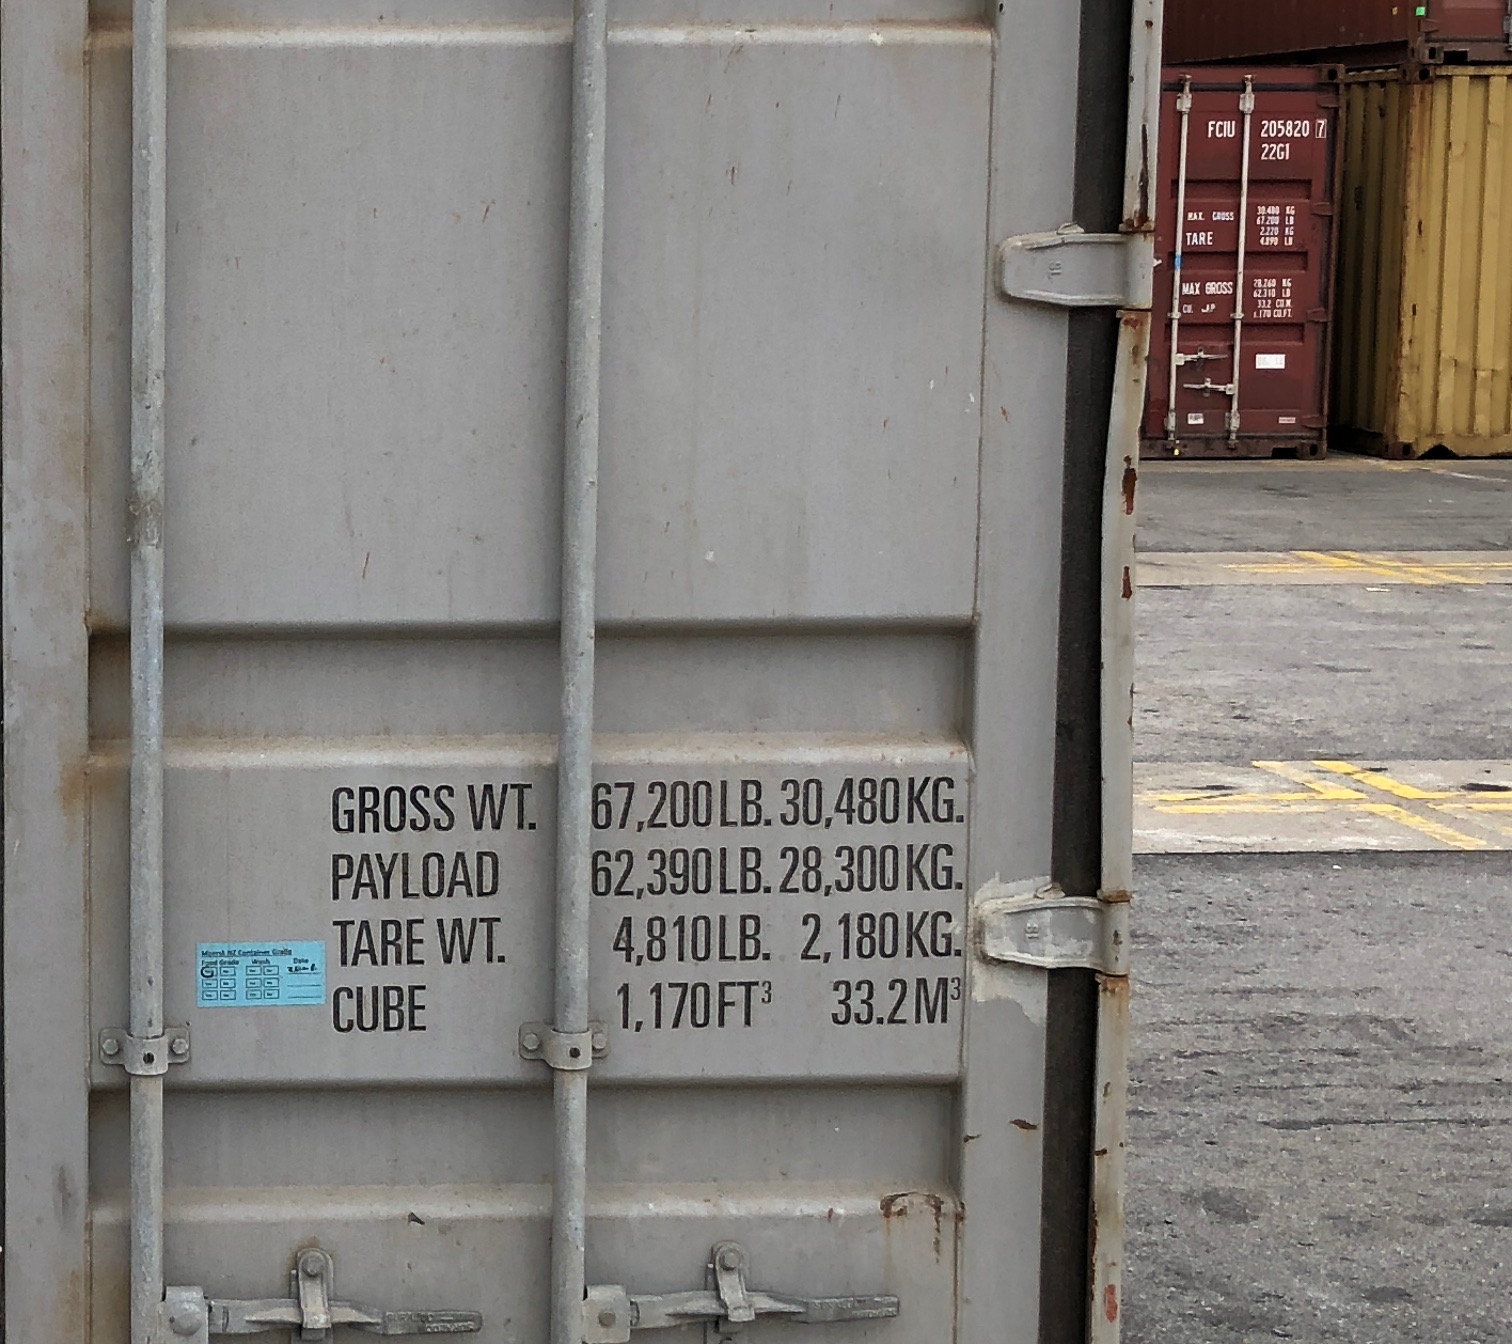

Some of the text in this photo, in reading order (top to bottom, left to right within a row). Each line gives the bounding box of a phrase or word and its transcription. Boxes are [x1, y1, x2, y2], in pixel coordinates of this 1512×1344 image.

[1208, 121, 1236, 138] FCIU
[1261, 120, 1310, 138] 205820
[1261, 143, 1291, 160] 22G1
[1186, 232, 1214, 245] TARE
[1182, 283, 1201, 295] MAX
[331, 776, 965, 835] GROSS WT. 67,200 LB. 30,480 KG.
[331, 844, 964, 901] PAYLOAD 62,390 LB. 28,300 KG.
[332, 910, 963, 968] TARE WT. 4,810 LB. 2,180 KG.
[332, 985, 427, 1033] CUBE
[616, 984, 710, 1034] 1,170
[831, 978, 908, 1026] 33.2
